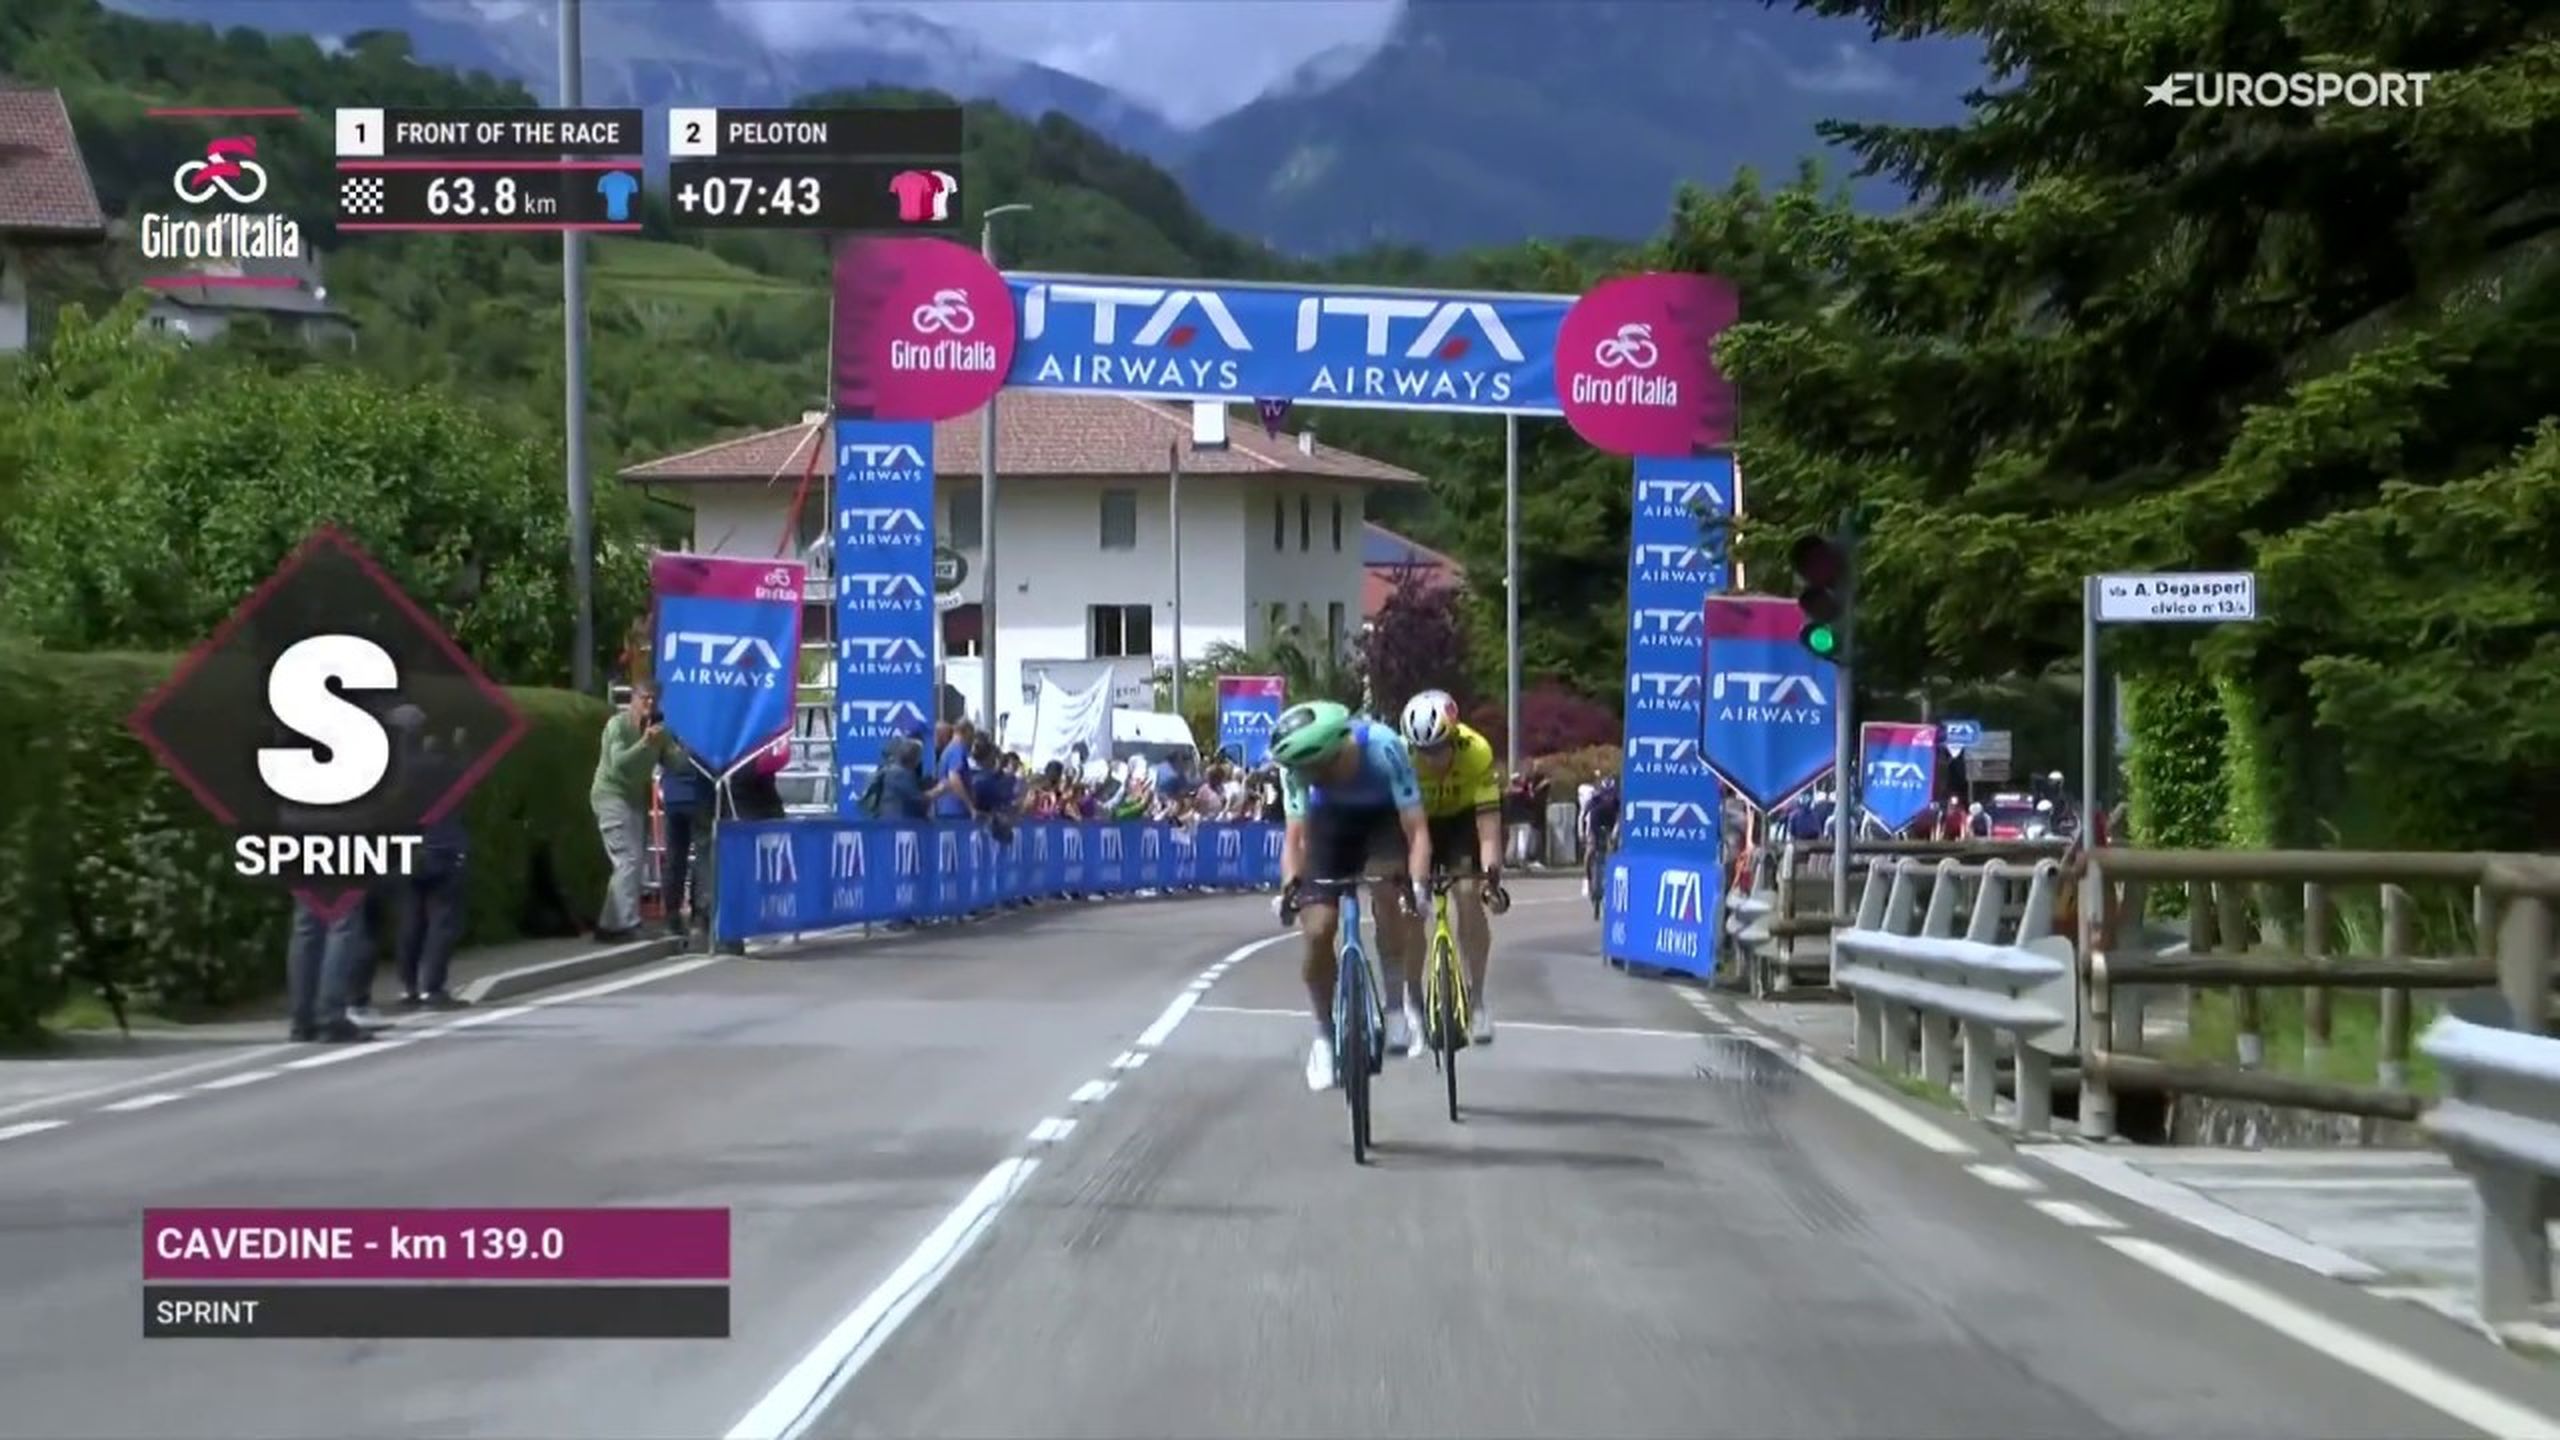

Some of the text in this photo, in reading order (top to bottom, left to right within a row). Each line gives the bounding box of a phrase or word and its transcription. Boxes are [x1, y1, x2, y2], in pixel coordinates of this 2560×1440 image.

[1023, 283, 1254, 350] ITA
[1296, 297, 1526, 362] ITA
[890, 338, 996, 373] Giro d'Italia
[1036, 353, 1238, 389] AIRWAYS
[1310, 365, 1512, 401] AIRWAYS
[1572, 372, 1678, 407] Giro d'Italia
[841, 443, 925, 467] ITA
[847, 470, 922, 481] AIRWAYS
[1638, 479, 1724, 505] ITA
[841, 508, 926, 531] ITA
[847, 533, 923, 545] AIRWAYS
[841, 573, 927, 596] ITA
[1641, 569, 1717, 584] AIRWAYS
[2134, 582, 2151, 597] A.
[847, 599, 923, 611] AIRWAYS
[663, 632, 783, 670] ITA
[841, 636, 927, 660] ITA
[1639, 633, 1703, 647] AIRWAY
[671, 667, 776, 689] AIRWAYS
[848, 662, 923, 675] AIRWAYS
[1713, 671, 1828, 706] ITA
[841, 700, 928, 723] ITA
[1637, 698, 1700, 712] AIRWAY
[1719, 706, 1821, 725] AIRWAYS
[848, 726, 911, 738] AIRWA
[1867, 761, 1926, 781] ITA
[1626, 801, 1711, 825] ITA
[1631, 825, 1707, 840] AIRWAYS
[1656, 869, 1703, 924] ITA
[1655, 927, 1698, 958] AIRWAYS
